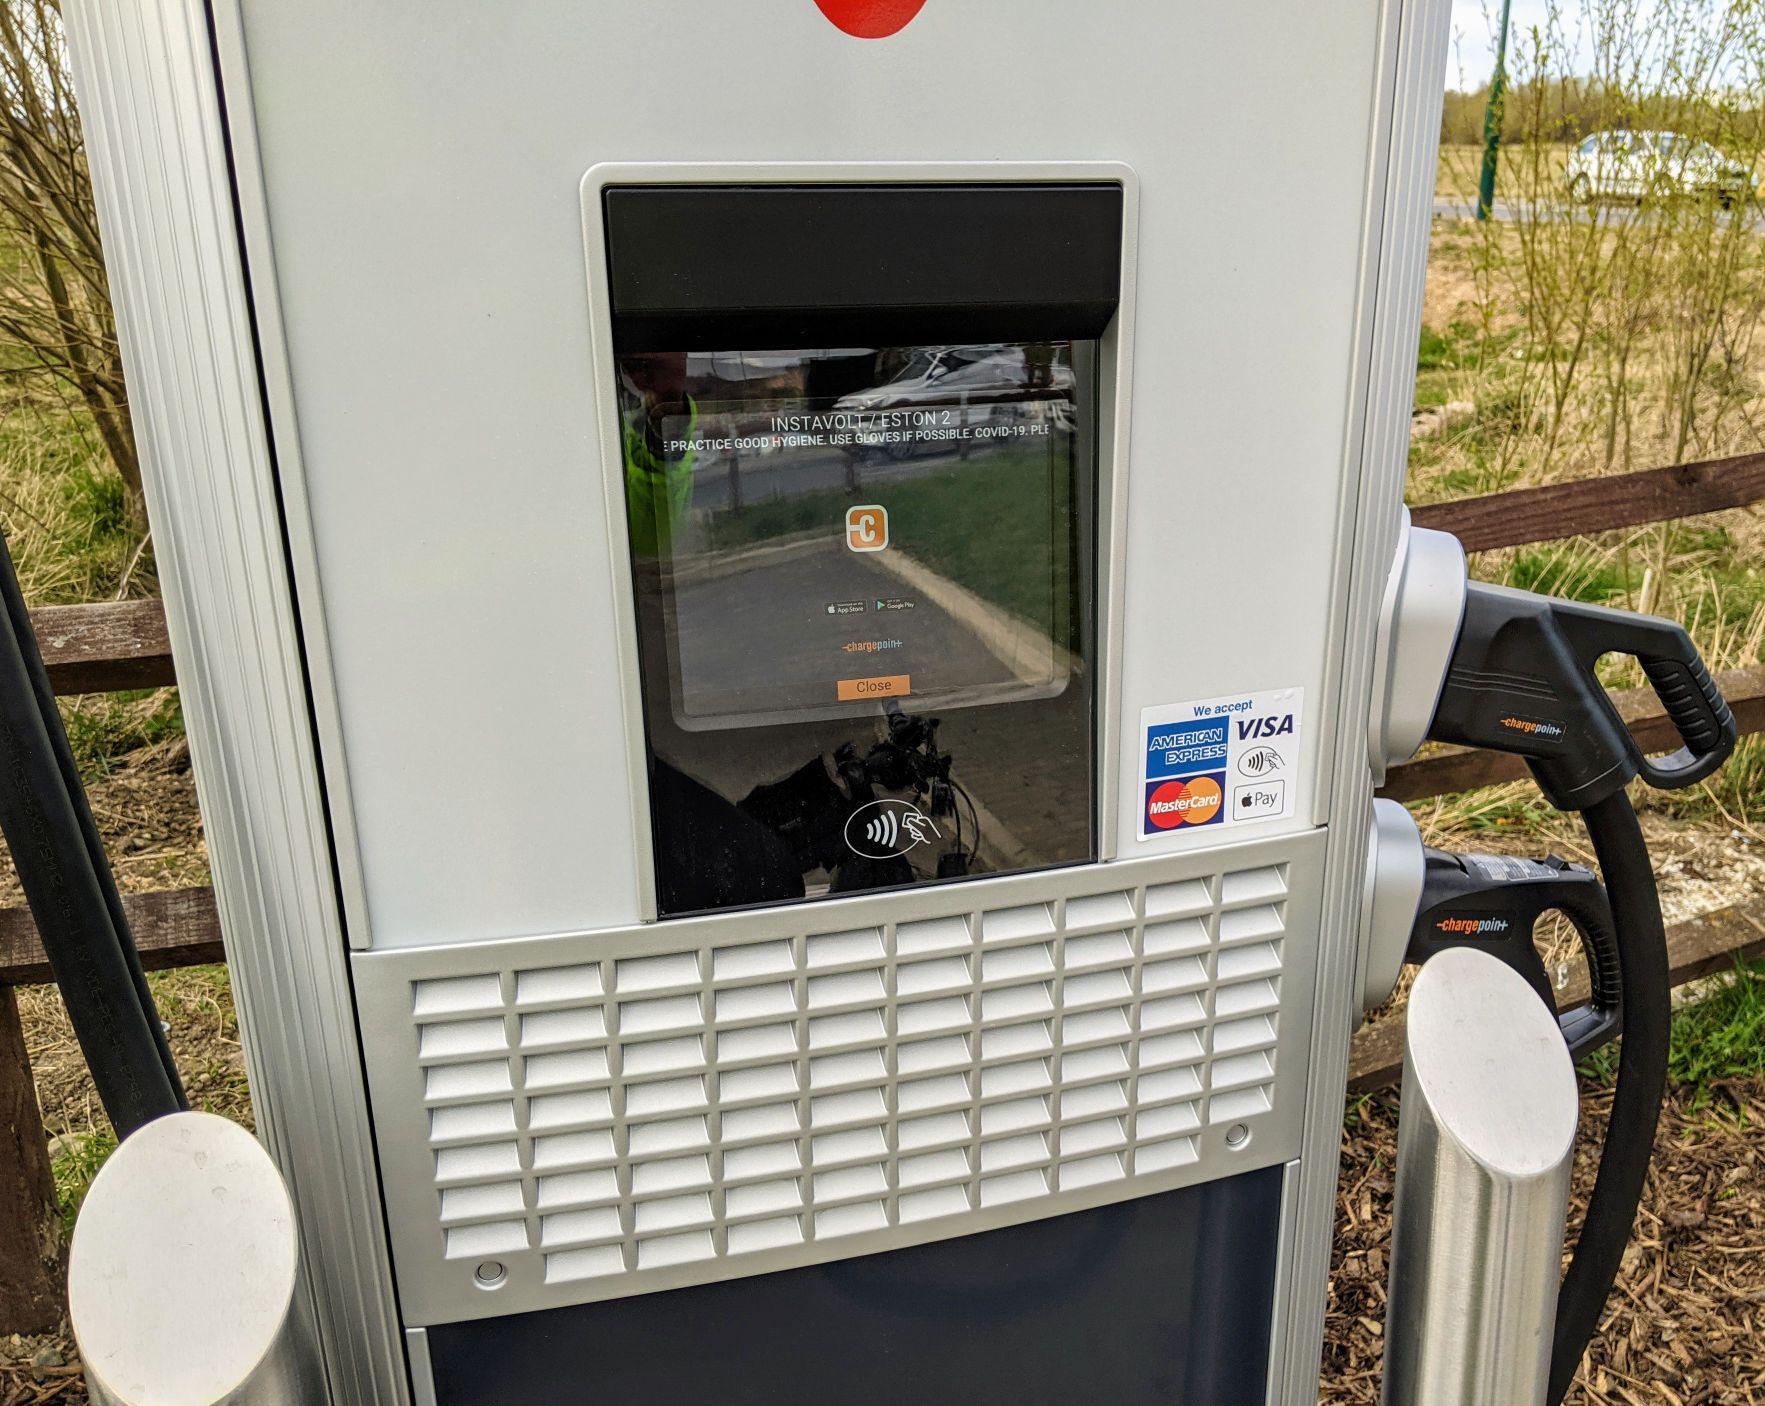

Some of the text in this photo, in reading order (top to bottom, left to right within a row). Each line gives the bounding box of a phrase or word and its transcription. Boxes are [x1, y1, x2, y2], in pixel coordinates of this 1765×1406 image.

[771, 413, 864, 431] INSTAVOLT
[881, 410, 936, 427] ESTON
[941, 410, 951, 425] 2
[670, 439, 732, 452] PRACTICE
[734, 437, 769, 449] GOOD
[772, 434, 827, 447] HYGIENE.
[829, 433, 853, 445] USE
[855, 431, 900, 444] GLOVES
[902, 431, 913, 441] IF
[915, 428, 973, 441] POSSIBLE.
[975, 425, 1028, 438] COVID-19.
[856, 681, 892, 693] Close
[1193, 700, 1253, 717] We accept
[1235, 714, 1293, 741] VISA
[1149, 727, 1223, 751] AMERICAN
[1165, 744, 1227, 765] EXPRESS
[1254, 791, 1278, 808] Pay
